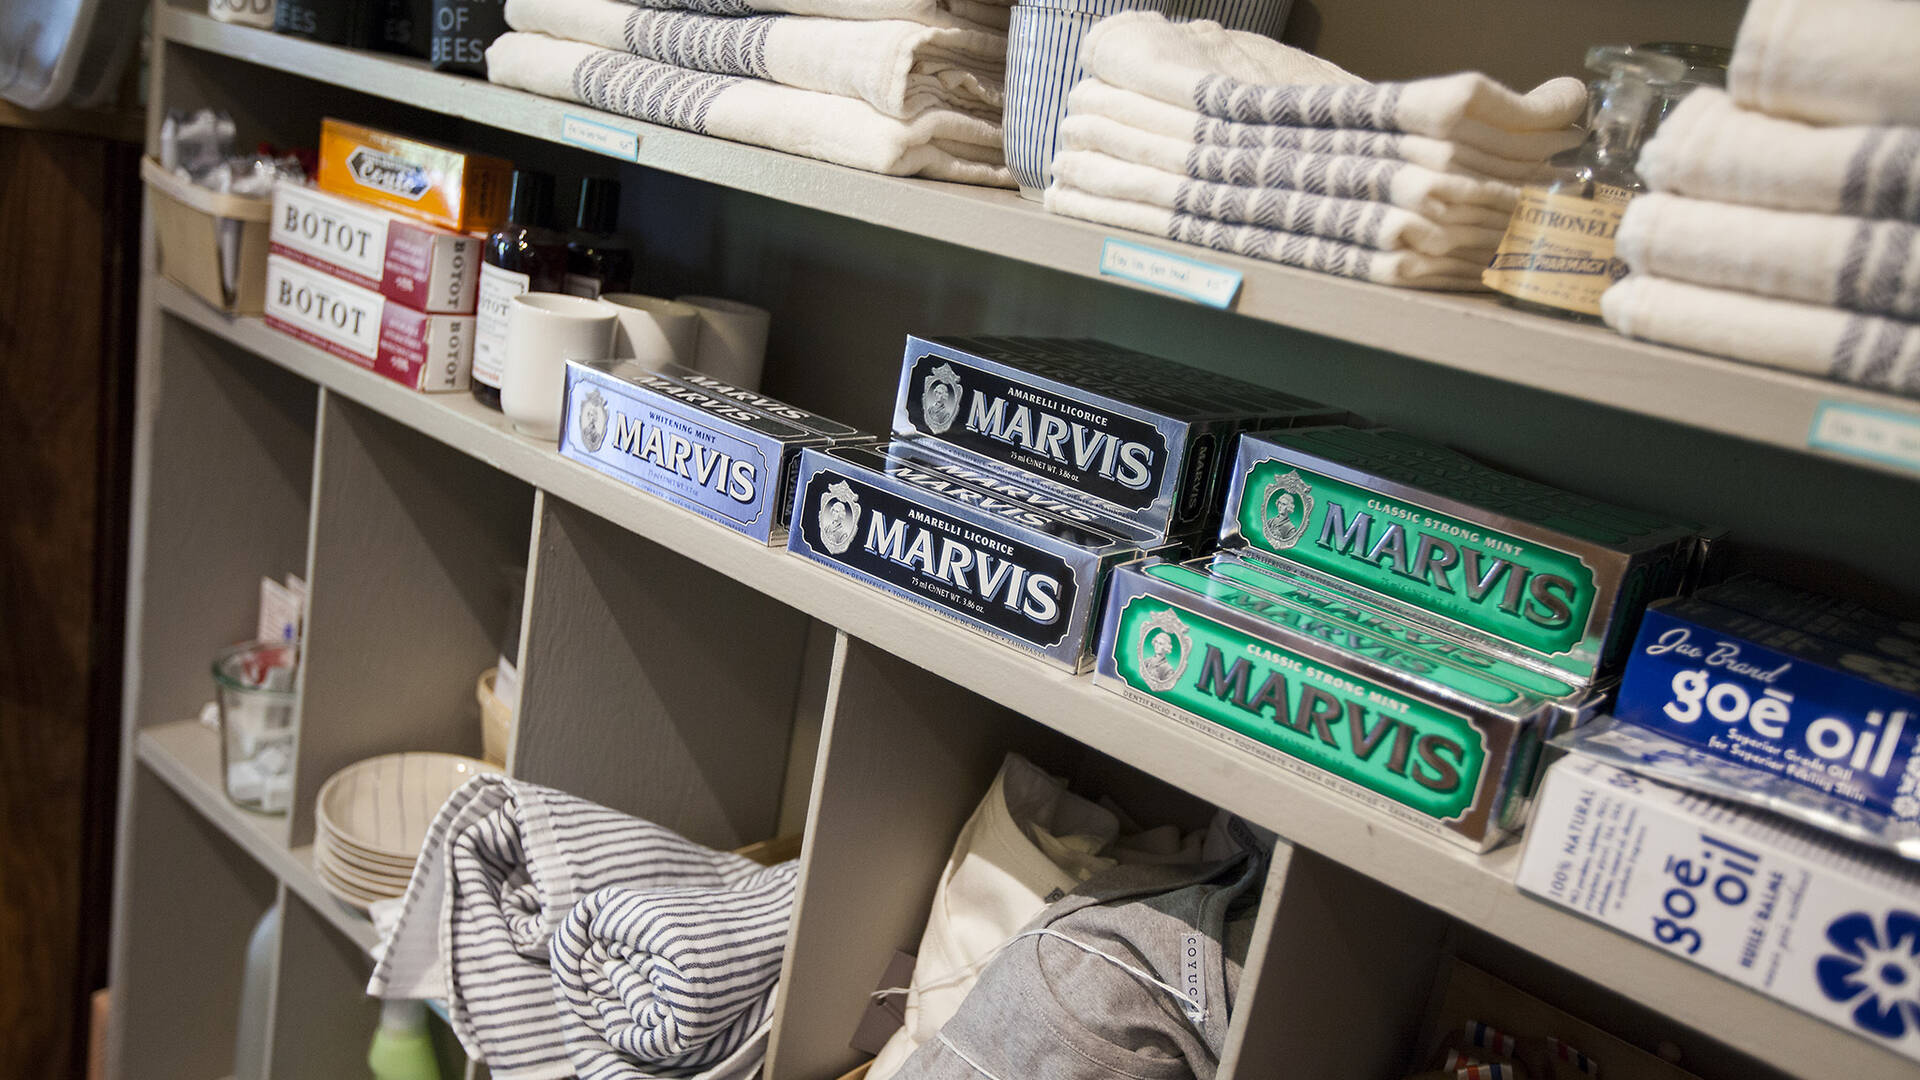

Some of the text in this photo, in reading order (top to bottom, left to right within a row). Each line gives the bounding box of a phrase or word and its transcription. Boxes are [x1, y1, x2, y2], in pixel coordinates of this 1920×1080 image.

[437, 7, 469, 31] OF
[285, 206, 372, 257] BOTOT
[448, 240, 466, 309] BOTOT
[279, 280, 366, 335] BOTOT
[446, 321, 462, 386] BOTOT
[632, 375, 761, 422] MARVIS
[682, 374, 811, 420] MARVIS
[1007, 386, 1108, 427] AMARELLI LICORICE
[649, 412, 717, 444] WHITENING MINT
[965, 388, 1154, 491] MARVIS
[613, 411, 757, 504] MARVIS
[890, 467, 1053, 526] MARVIS
[934, 465, 1099, 522] MARVIS
[908, 508, 1014, 556] AMARELLI LICORICE
[1367, 498, 1524, 556] CLASSIC STRONG MINT
[864, 509, 1061, 625] MARVIS
[911, 576, 919, 586] 75
[919, 580, 928, 590] ml
[950, 592, 961, 604] WT.
[962, 598, 976, 611] 3.86
[1315, 500, 1576, 631] MARVIS
[1223, 591, 1439, 675] MARVIS
[1282, 588, 1497, 669] MARVIS
[1646, 628, 1792, 683] Jao Brand
[1122, 690, 1170, 714] DENTIFRICIO
[1246, 643, 1410, 714] CLASSIC STRONG MINT
[1194, 643, 1465, 793] MARVIS
[1727, 728, 1782, 755] Superior
[1805, 710, 1909, 779] oil
[1729, 743, 1785, 770] Superior
[1549, 860, 1573, 897] 100%
[1563, 789, 1596, 855] NATURAL
[1700, 833, 1761, 906] oil
